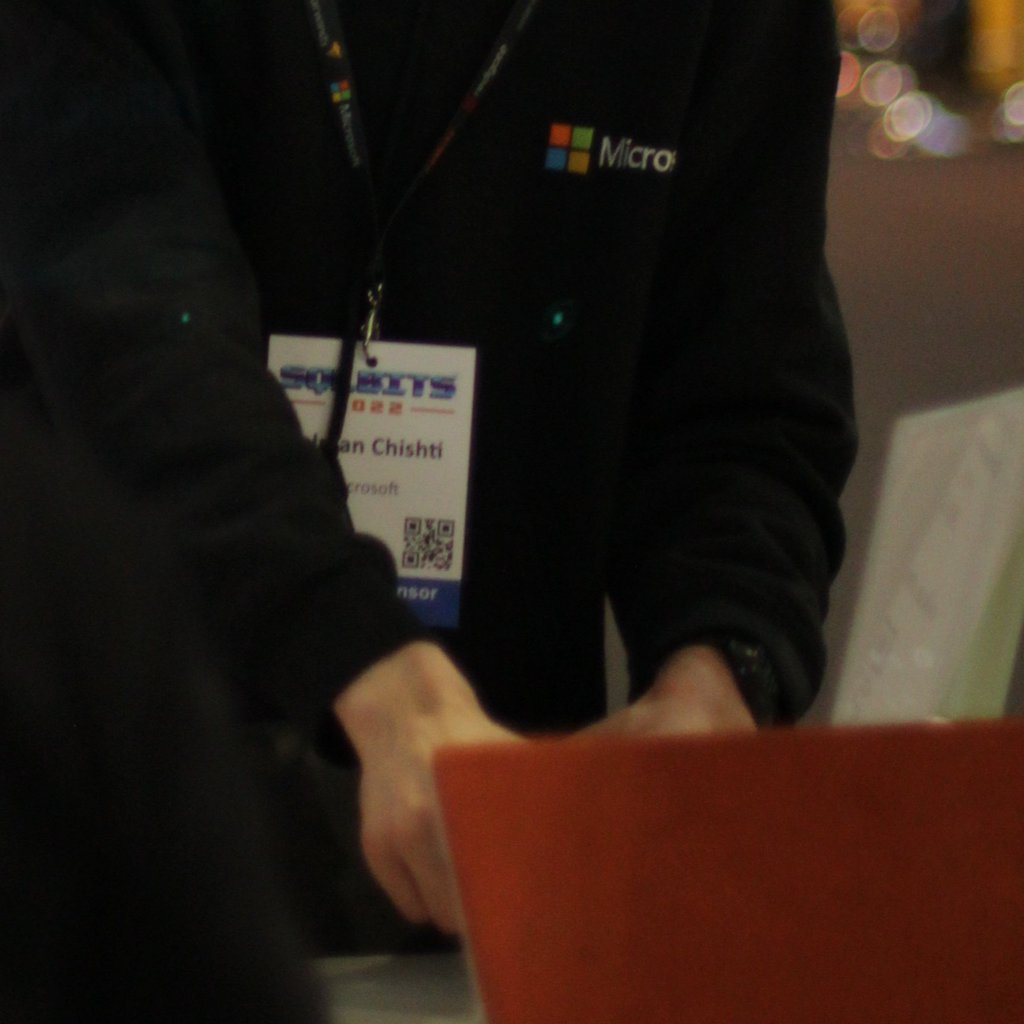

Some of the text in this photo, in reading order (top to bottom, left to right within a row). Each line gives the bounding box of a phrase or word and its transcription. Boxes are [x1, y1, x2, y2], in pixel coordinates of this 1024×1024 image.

[280, 365, 456, 398] SQBITS
[352, 399, 402, 416] 022
[372, 437, 443, 460] Chishti
[347, 481, 400, 496] crosoft
[397, 585, 437, 601] nsor
